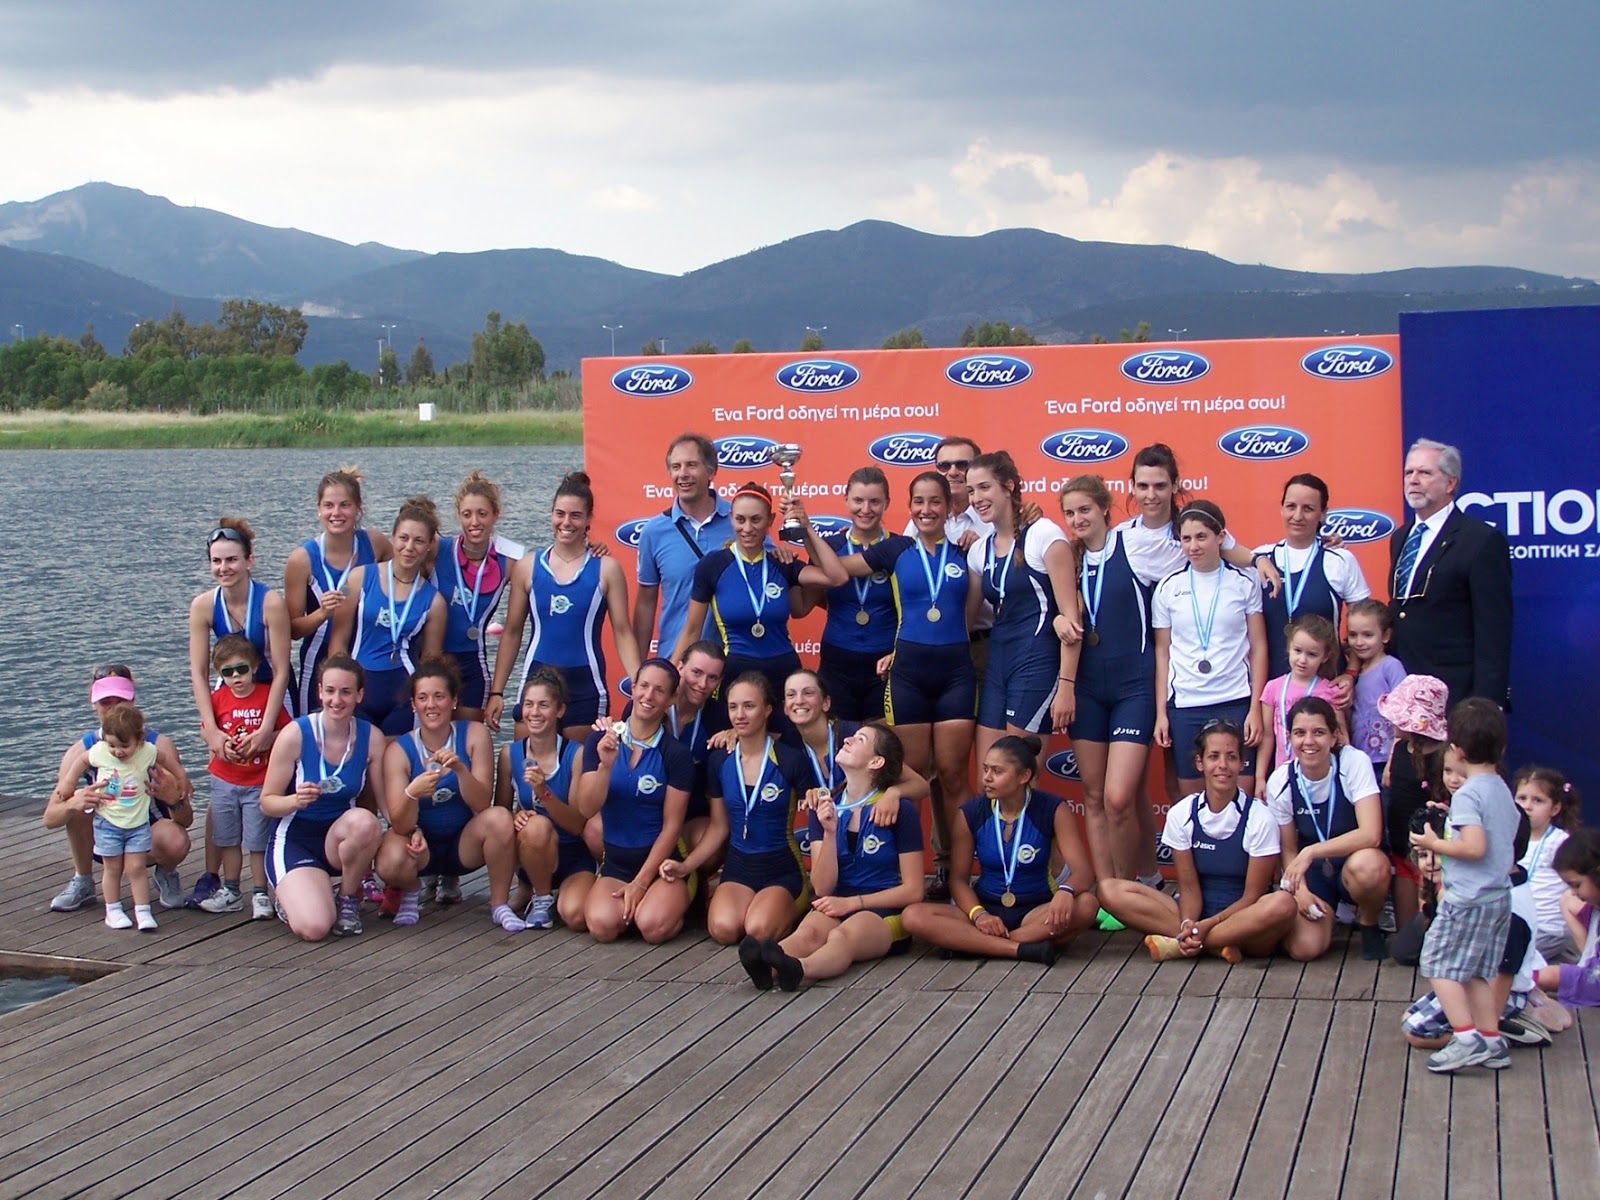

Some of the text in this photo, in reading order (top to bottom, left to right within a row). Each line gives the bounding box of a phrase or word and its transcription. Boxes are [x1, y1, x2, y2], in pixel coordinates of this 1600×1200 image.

[961, 359, 1017, 383] Ford
[1136, 354, 1194, 378] Ford
[1318, 350, 1377, 374] Ford
[626, 369, 678, 391] Ford
[791, 364, 845, 387] Ford
[712, 403, 939, 422] Ένα Ford οδηγεί τη μέρα σου!
[1045, 395, 1285, 414] Ένα Ford οδηγεί τη μέρα σου!
[717, 441, 770, 463] Ford
[884, 437, 938, 460] Ford
[1056, 433, 1113, 457] Ford
[1234, 430, 1293, 454] Ford
[643, 485, 673, 498] Ένα
[1105, 482, 1124, 494] τη
[1180, 476, 1208, 490] ου!
[1455, 489, 1600, 536] CTIO
[1320, 513, 1379, 537] Ford
[233, 709, 261, 718] ANGRY
